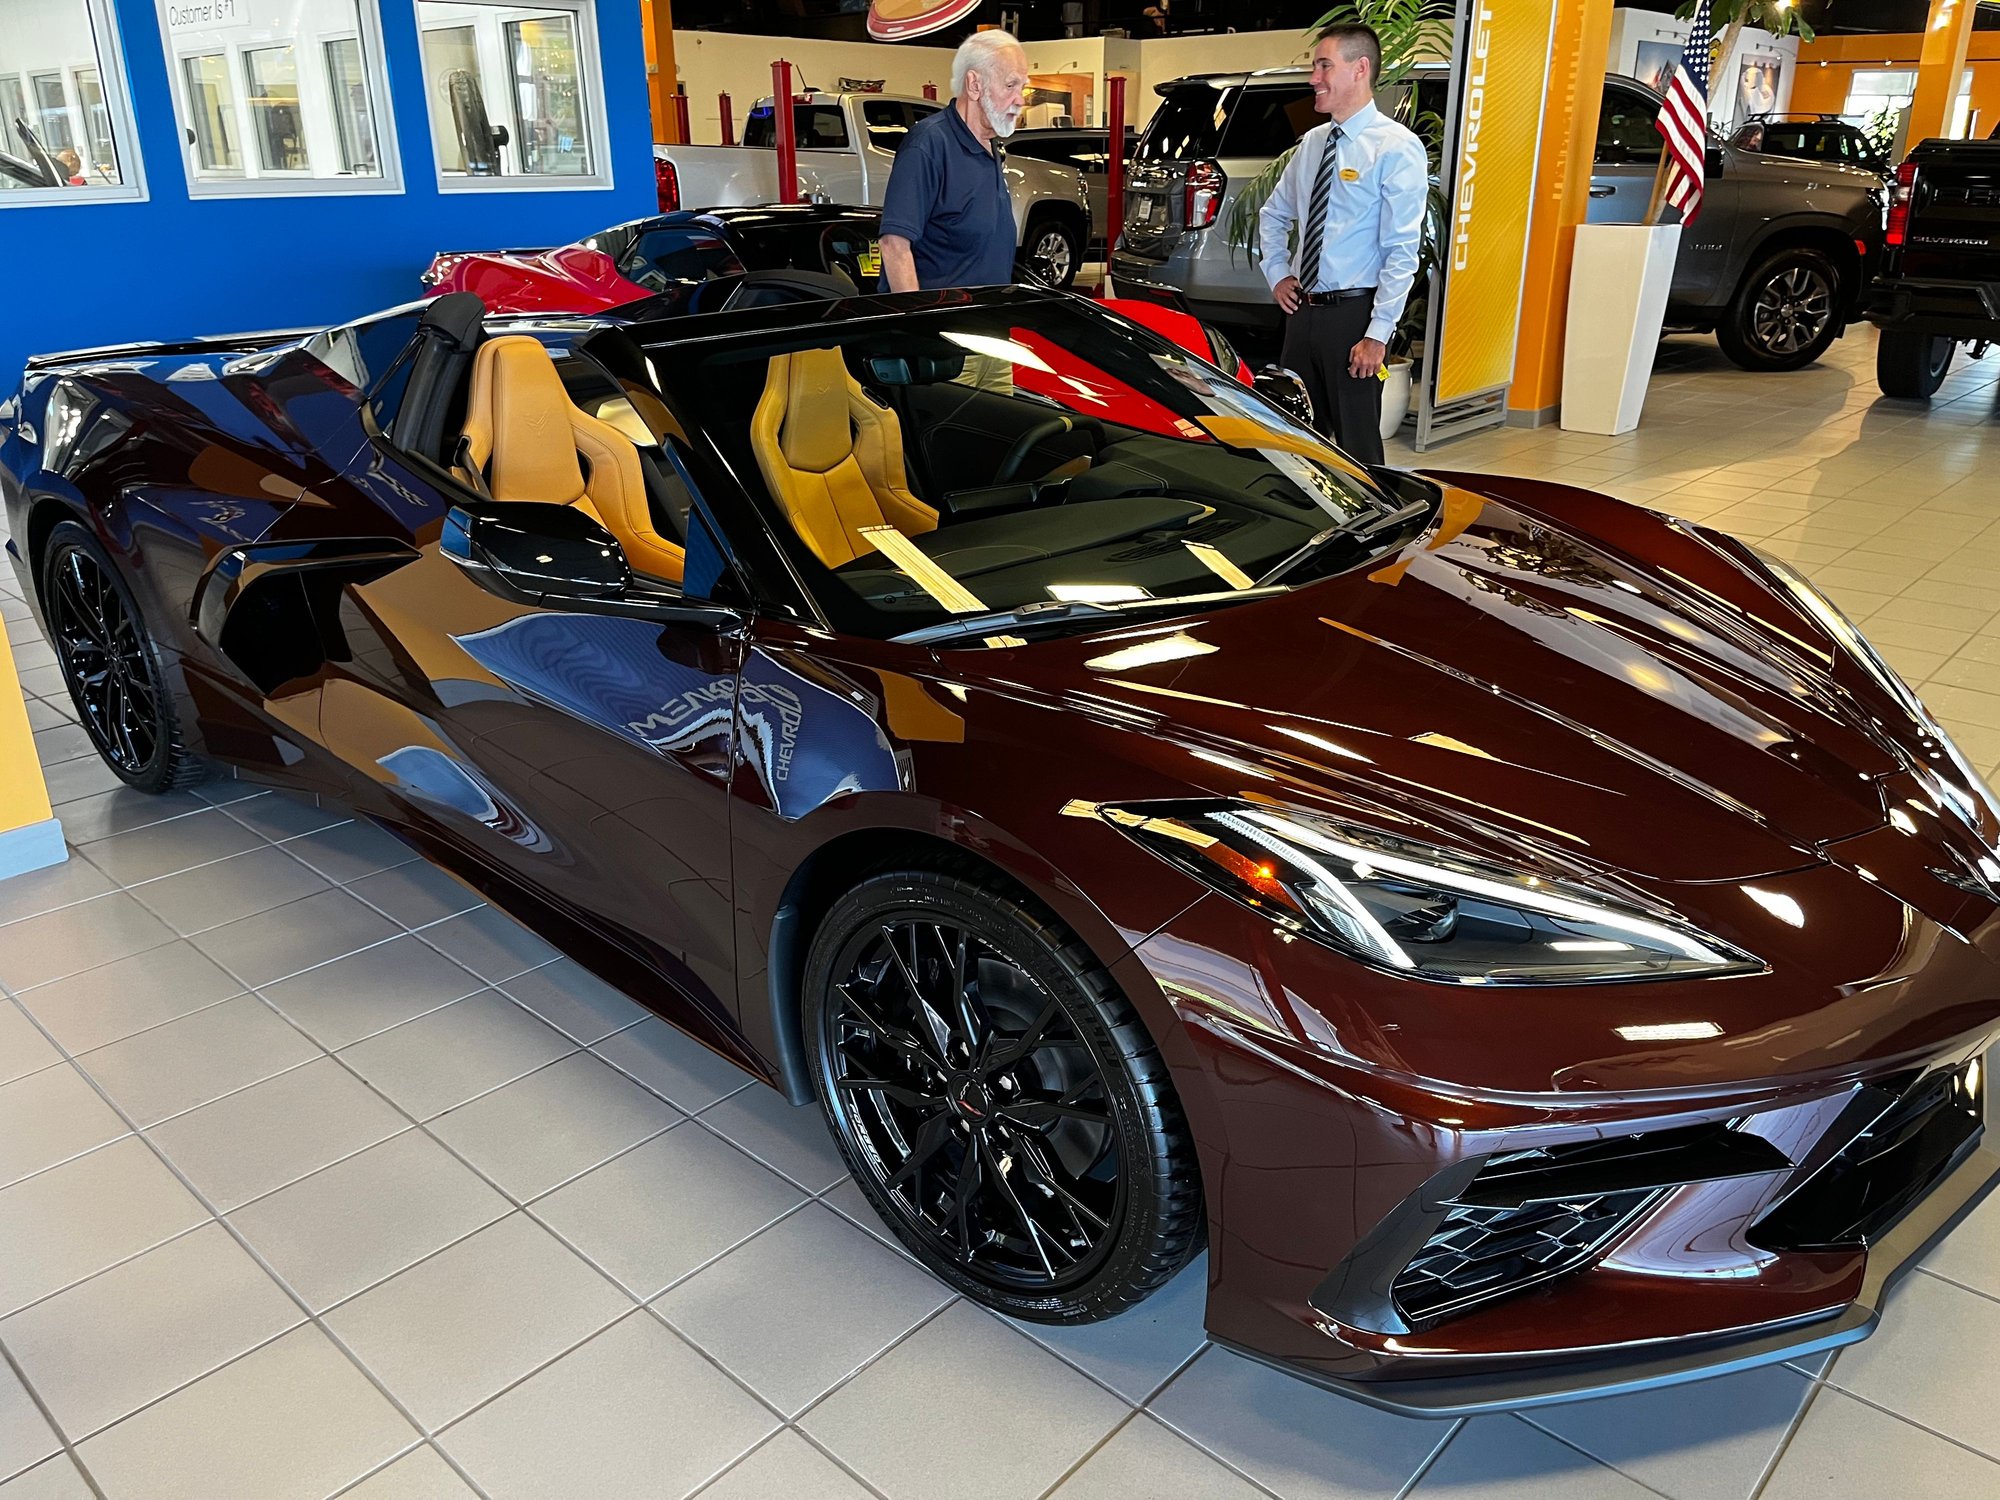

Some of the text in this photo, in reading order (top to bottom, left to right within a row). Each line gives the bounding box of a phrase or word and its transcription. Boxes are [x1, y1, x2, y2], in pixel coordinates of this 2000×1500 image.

[169, 5, 212, 26] Customer
[1454, 0, 1493, 271] CHEVROLET
[1912, 236, 1989, 246] SILVERADO
